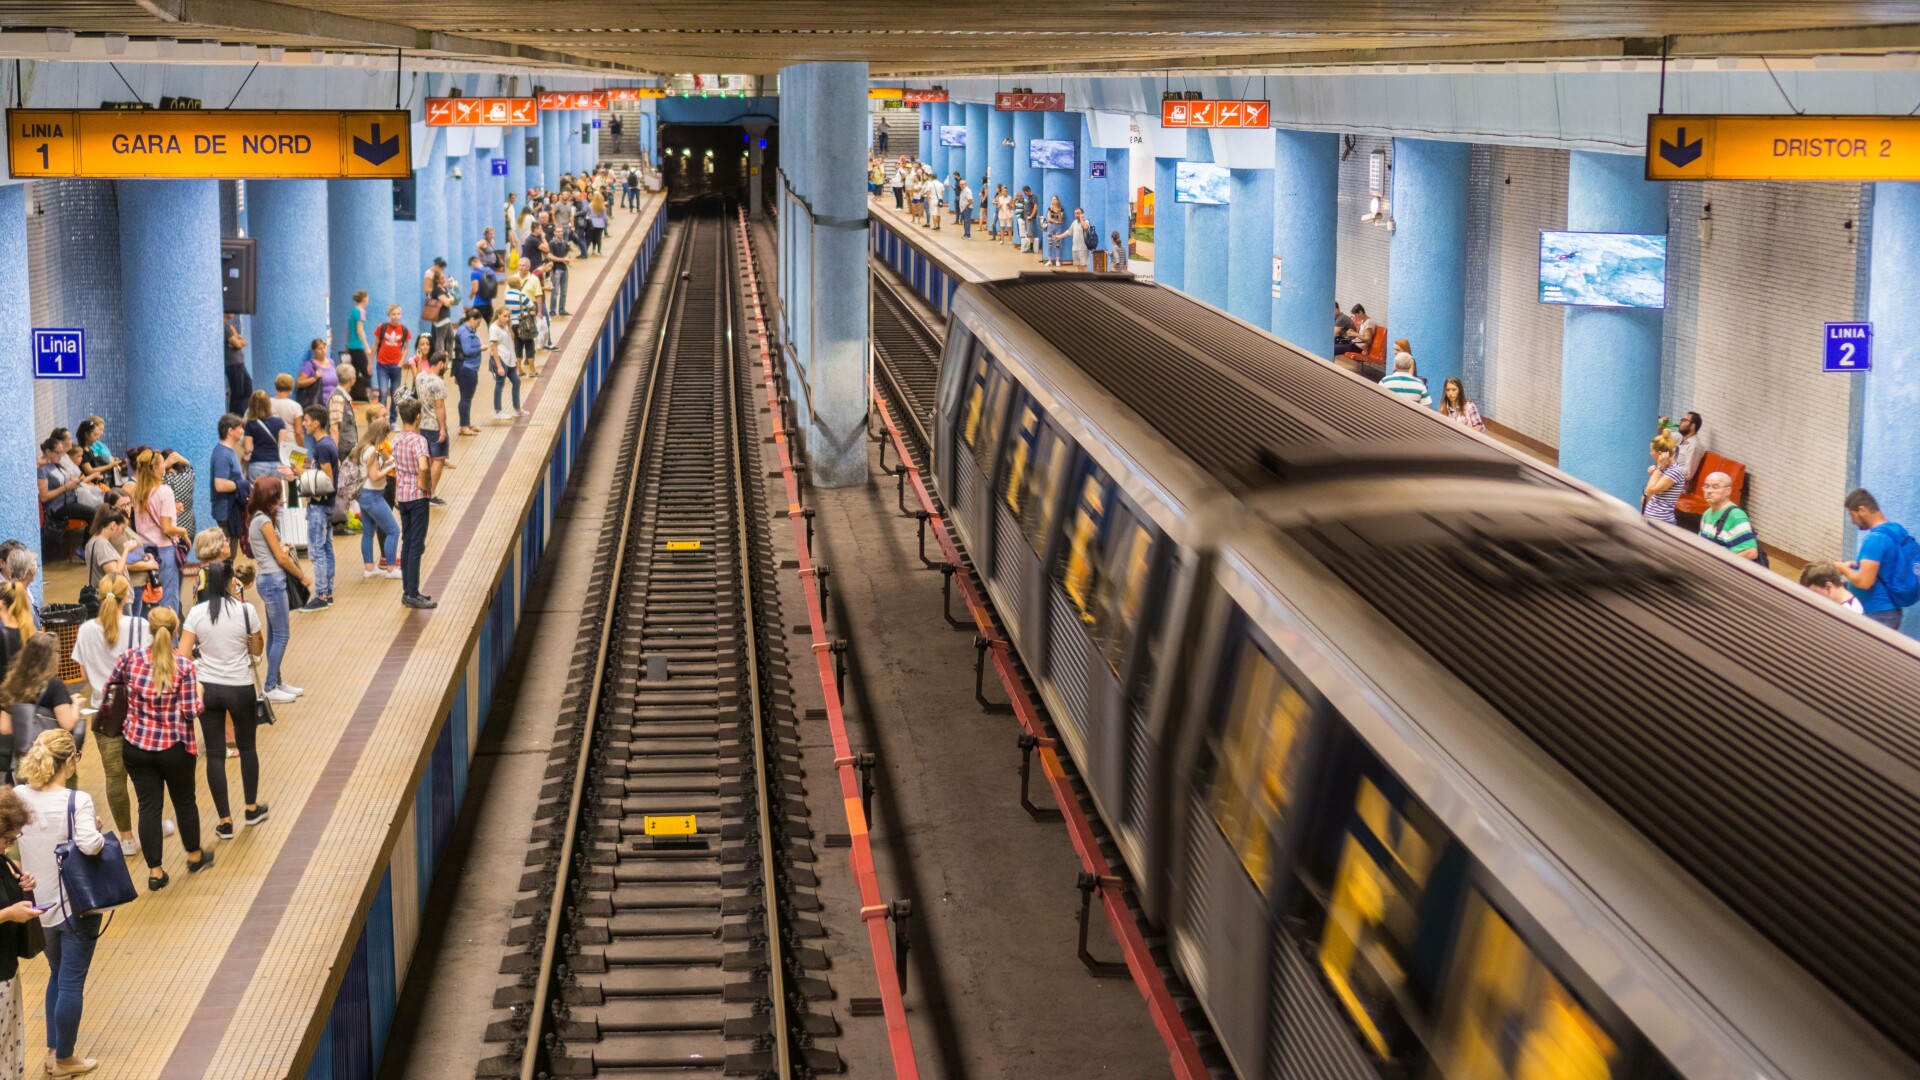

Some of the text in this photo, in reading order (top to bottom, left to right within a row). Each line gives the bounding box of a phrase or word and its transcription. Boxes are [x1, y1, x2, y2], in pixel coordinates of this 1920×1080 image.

[22, 124, 63, 137] LINIA
[112, 134, 312, 154] GARA DE NORD
[1773, 138, 1891, 157] DRISTOR 2
[36, 144, 48, 169] 1
[498, 165, 502, 175] 1
[1830, 328, 1866, 338] LINIA
[41, 336, 77, 353] Linia
[54, 354, 63, 372] 1
[1839, 342, 1855, 366] 2
